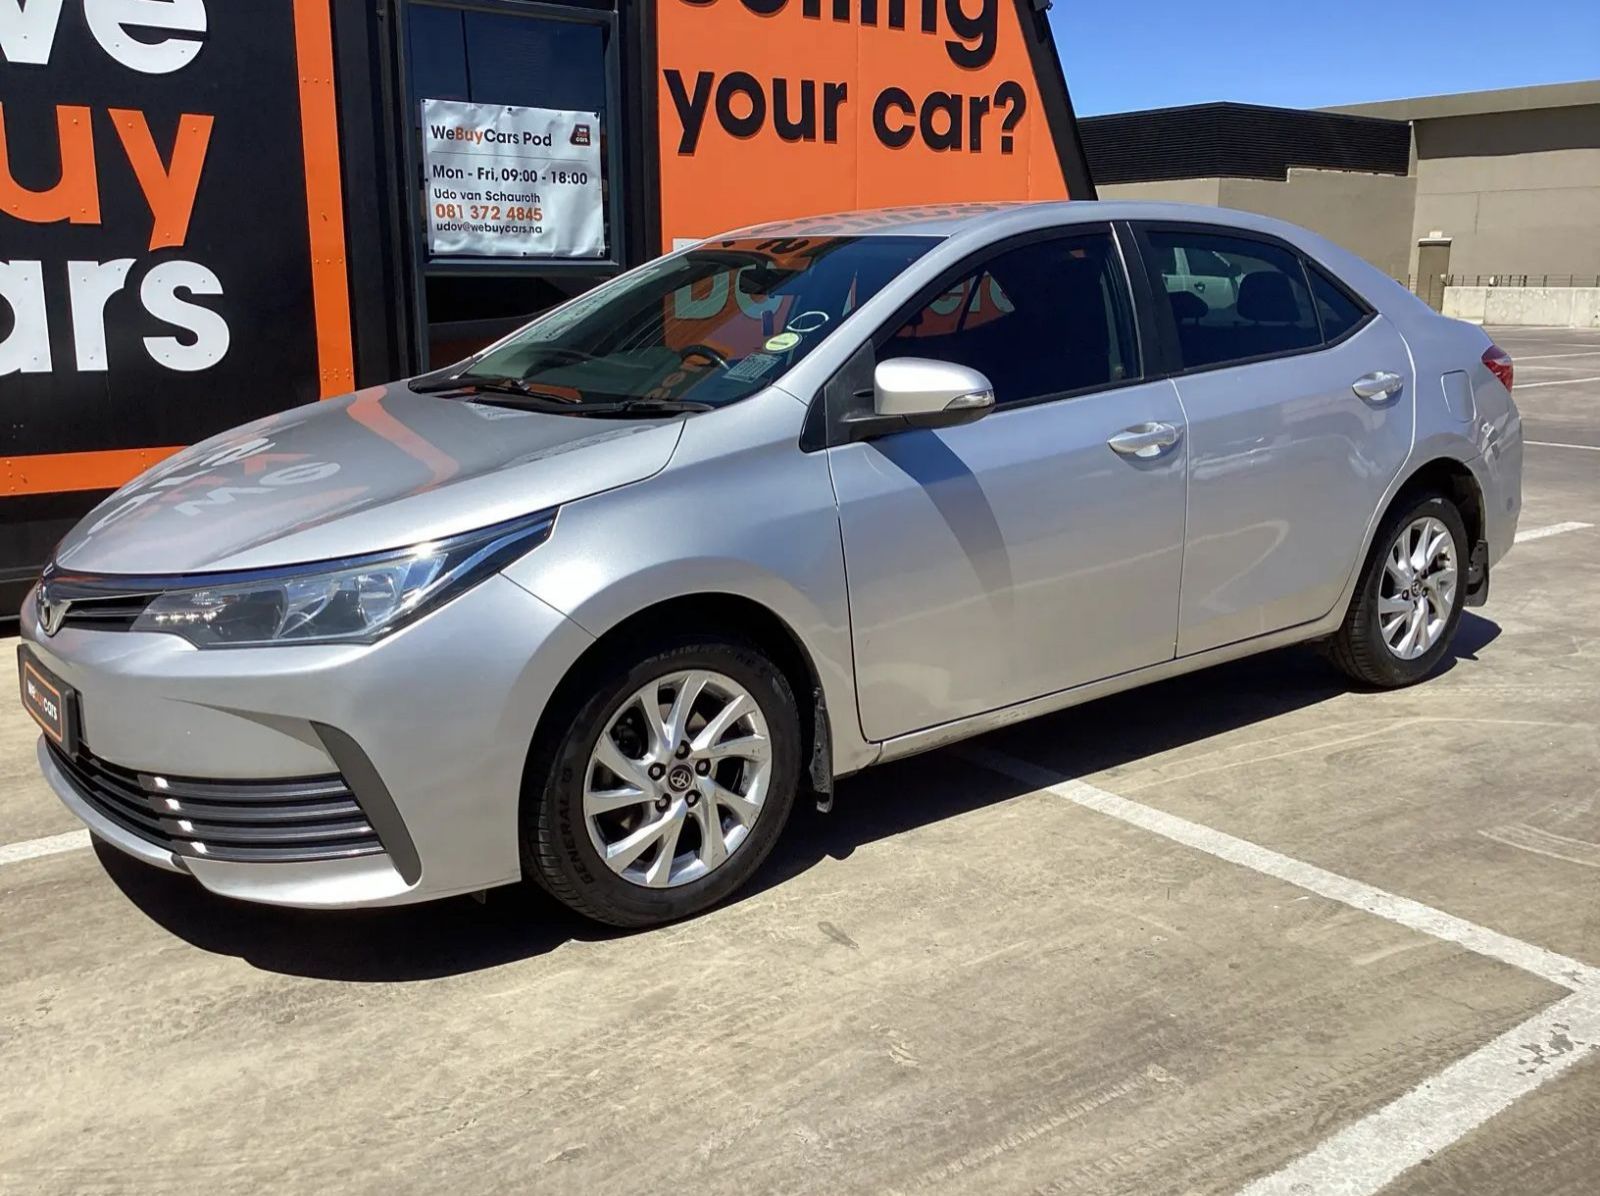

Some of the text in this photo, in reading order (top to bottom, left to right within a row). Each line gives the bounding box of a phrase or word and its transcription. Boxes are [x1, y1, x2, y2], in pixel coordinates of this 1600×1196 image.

[662, 68, 1027, 157] your car?
[431, 125, 552, 147] WeBuyCars Pod
[432, 164, 464, 179] Mon
[477, 166, 498, 182] Fri,
[501, 168, 538, 183] 09:00
[552, 171, 588, 185] 18:00
[434, 188, 541, 203] Udo van Schauroth
[435, 203, 543, 222] 081 372 4845
[436, 221, 543, 234] udov@webuycars.na
